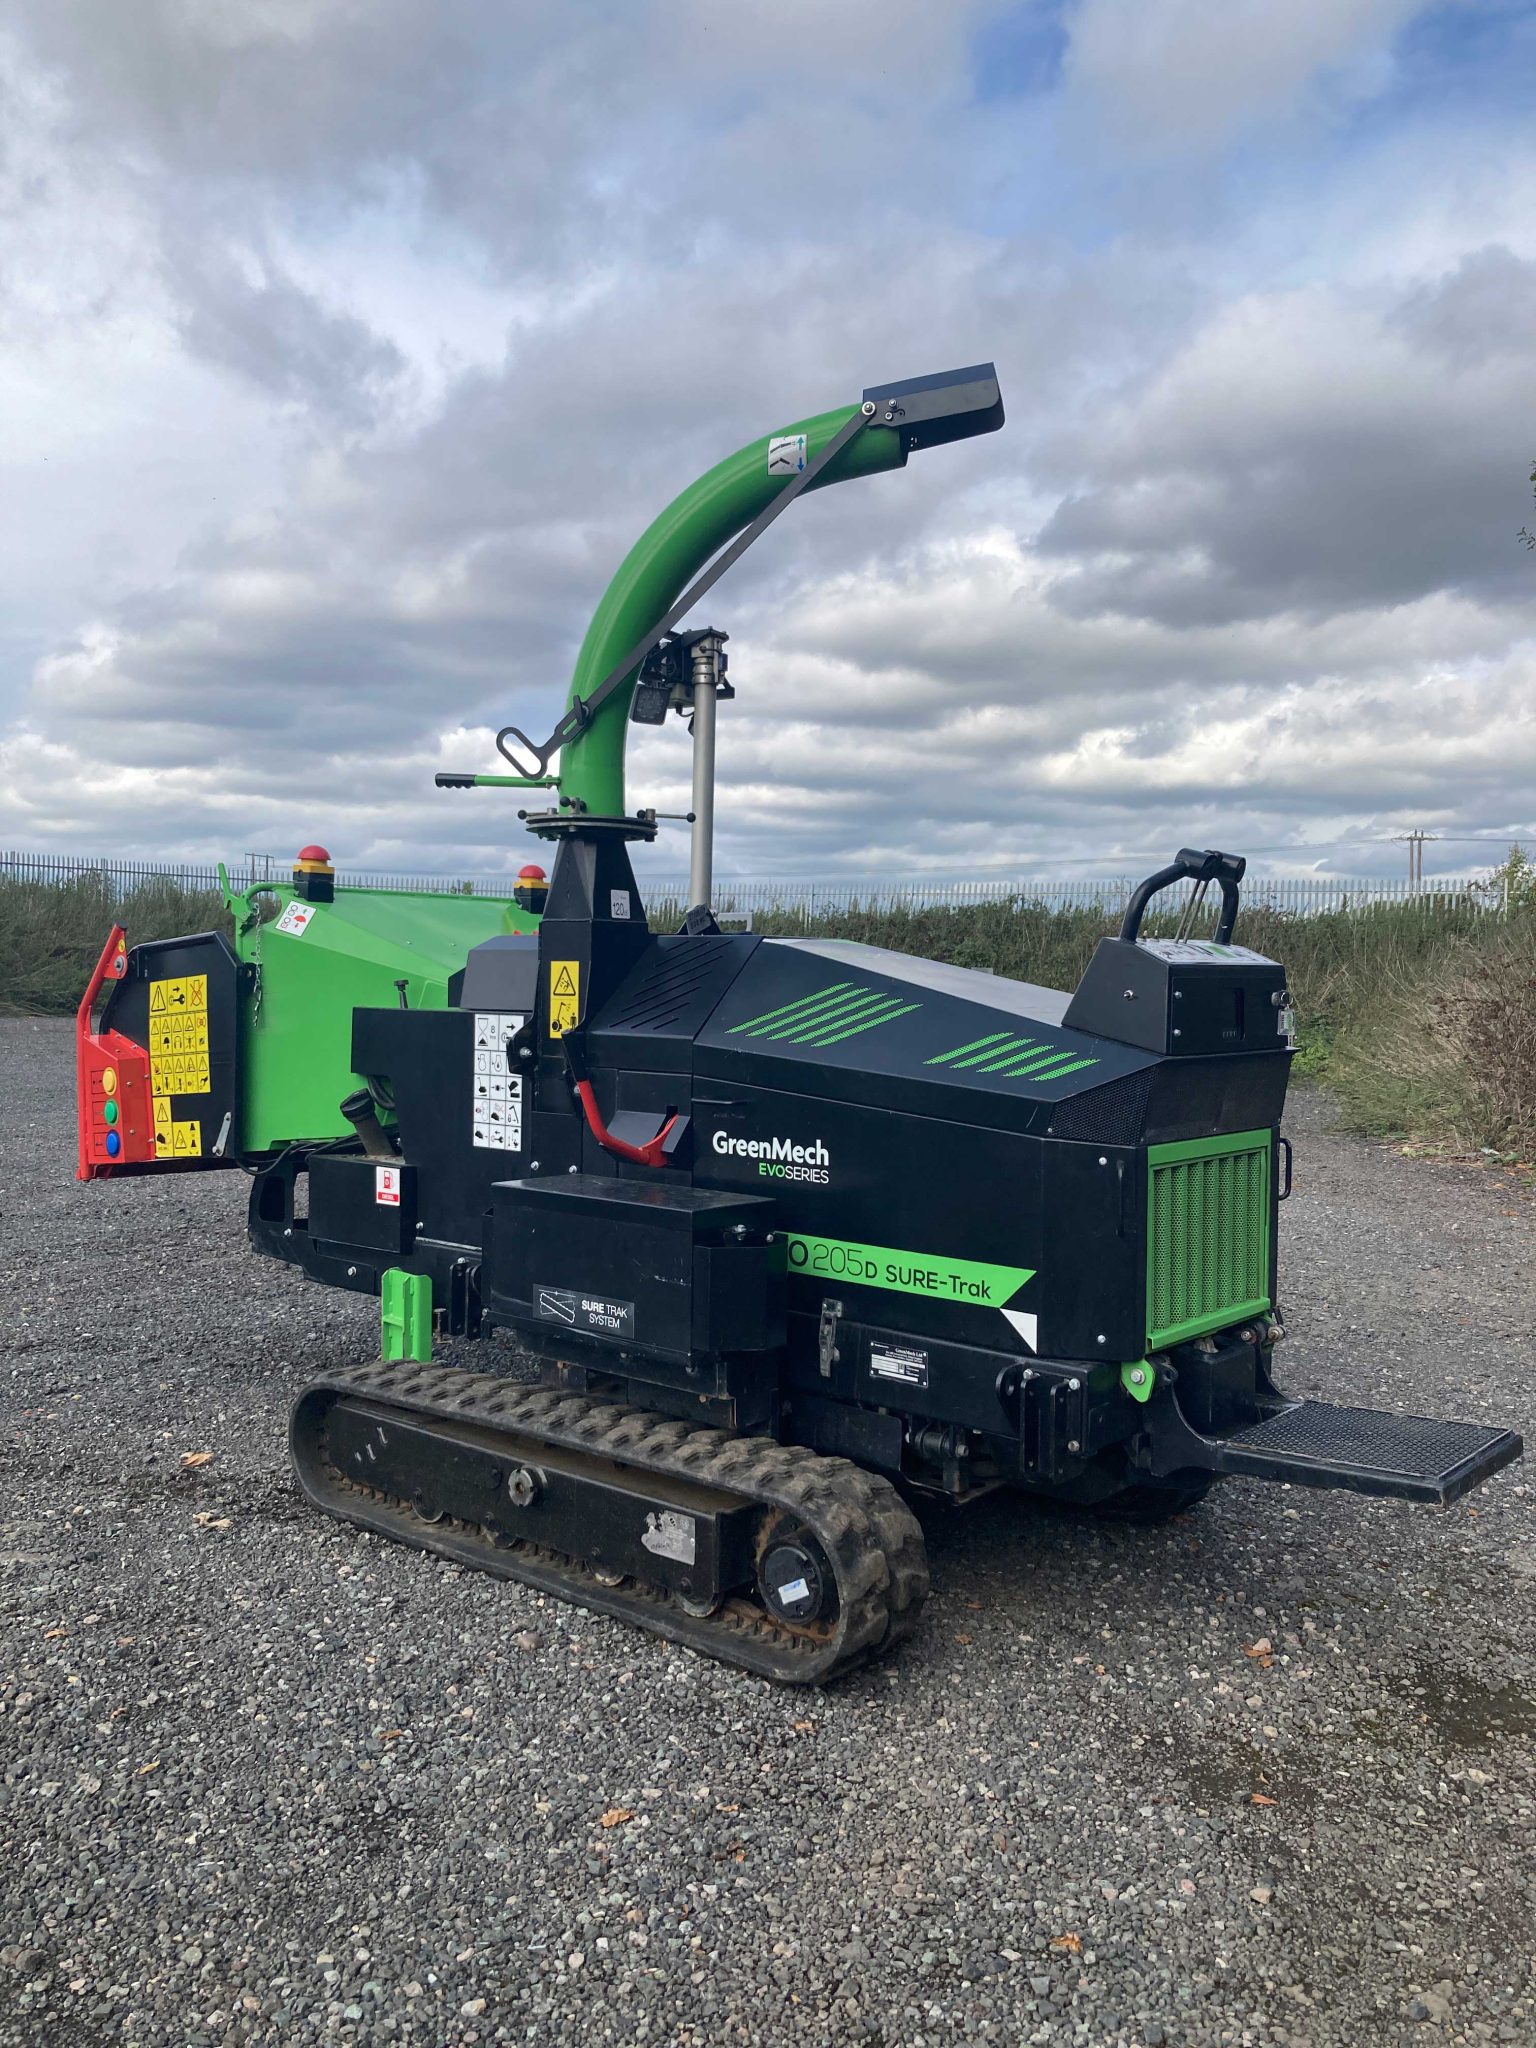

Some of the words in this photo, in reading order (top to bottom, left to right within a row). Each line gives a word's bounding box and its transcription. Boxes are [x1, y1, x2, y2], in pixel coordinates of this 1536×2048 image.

[712, 1130, 830, 1166] GreenMech
[759, 1162, 830, 1184] EVOSERIES
[885, 1264, 992, 1300] SURE-Trak
[581, 1300, 605, 1314] SURE
[605, 1304, 628, 1319] TRAK
[588, 1313, 620, 1329] SYSTEM
